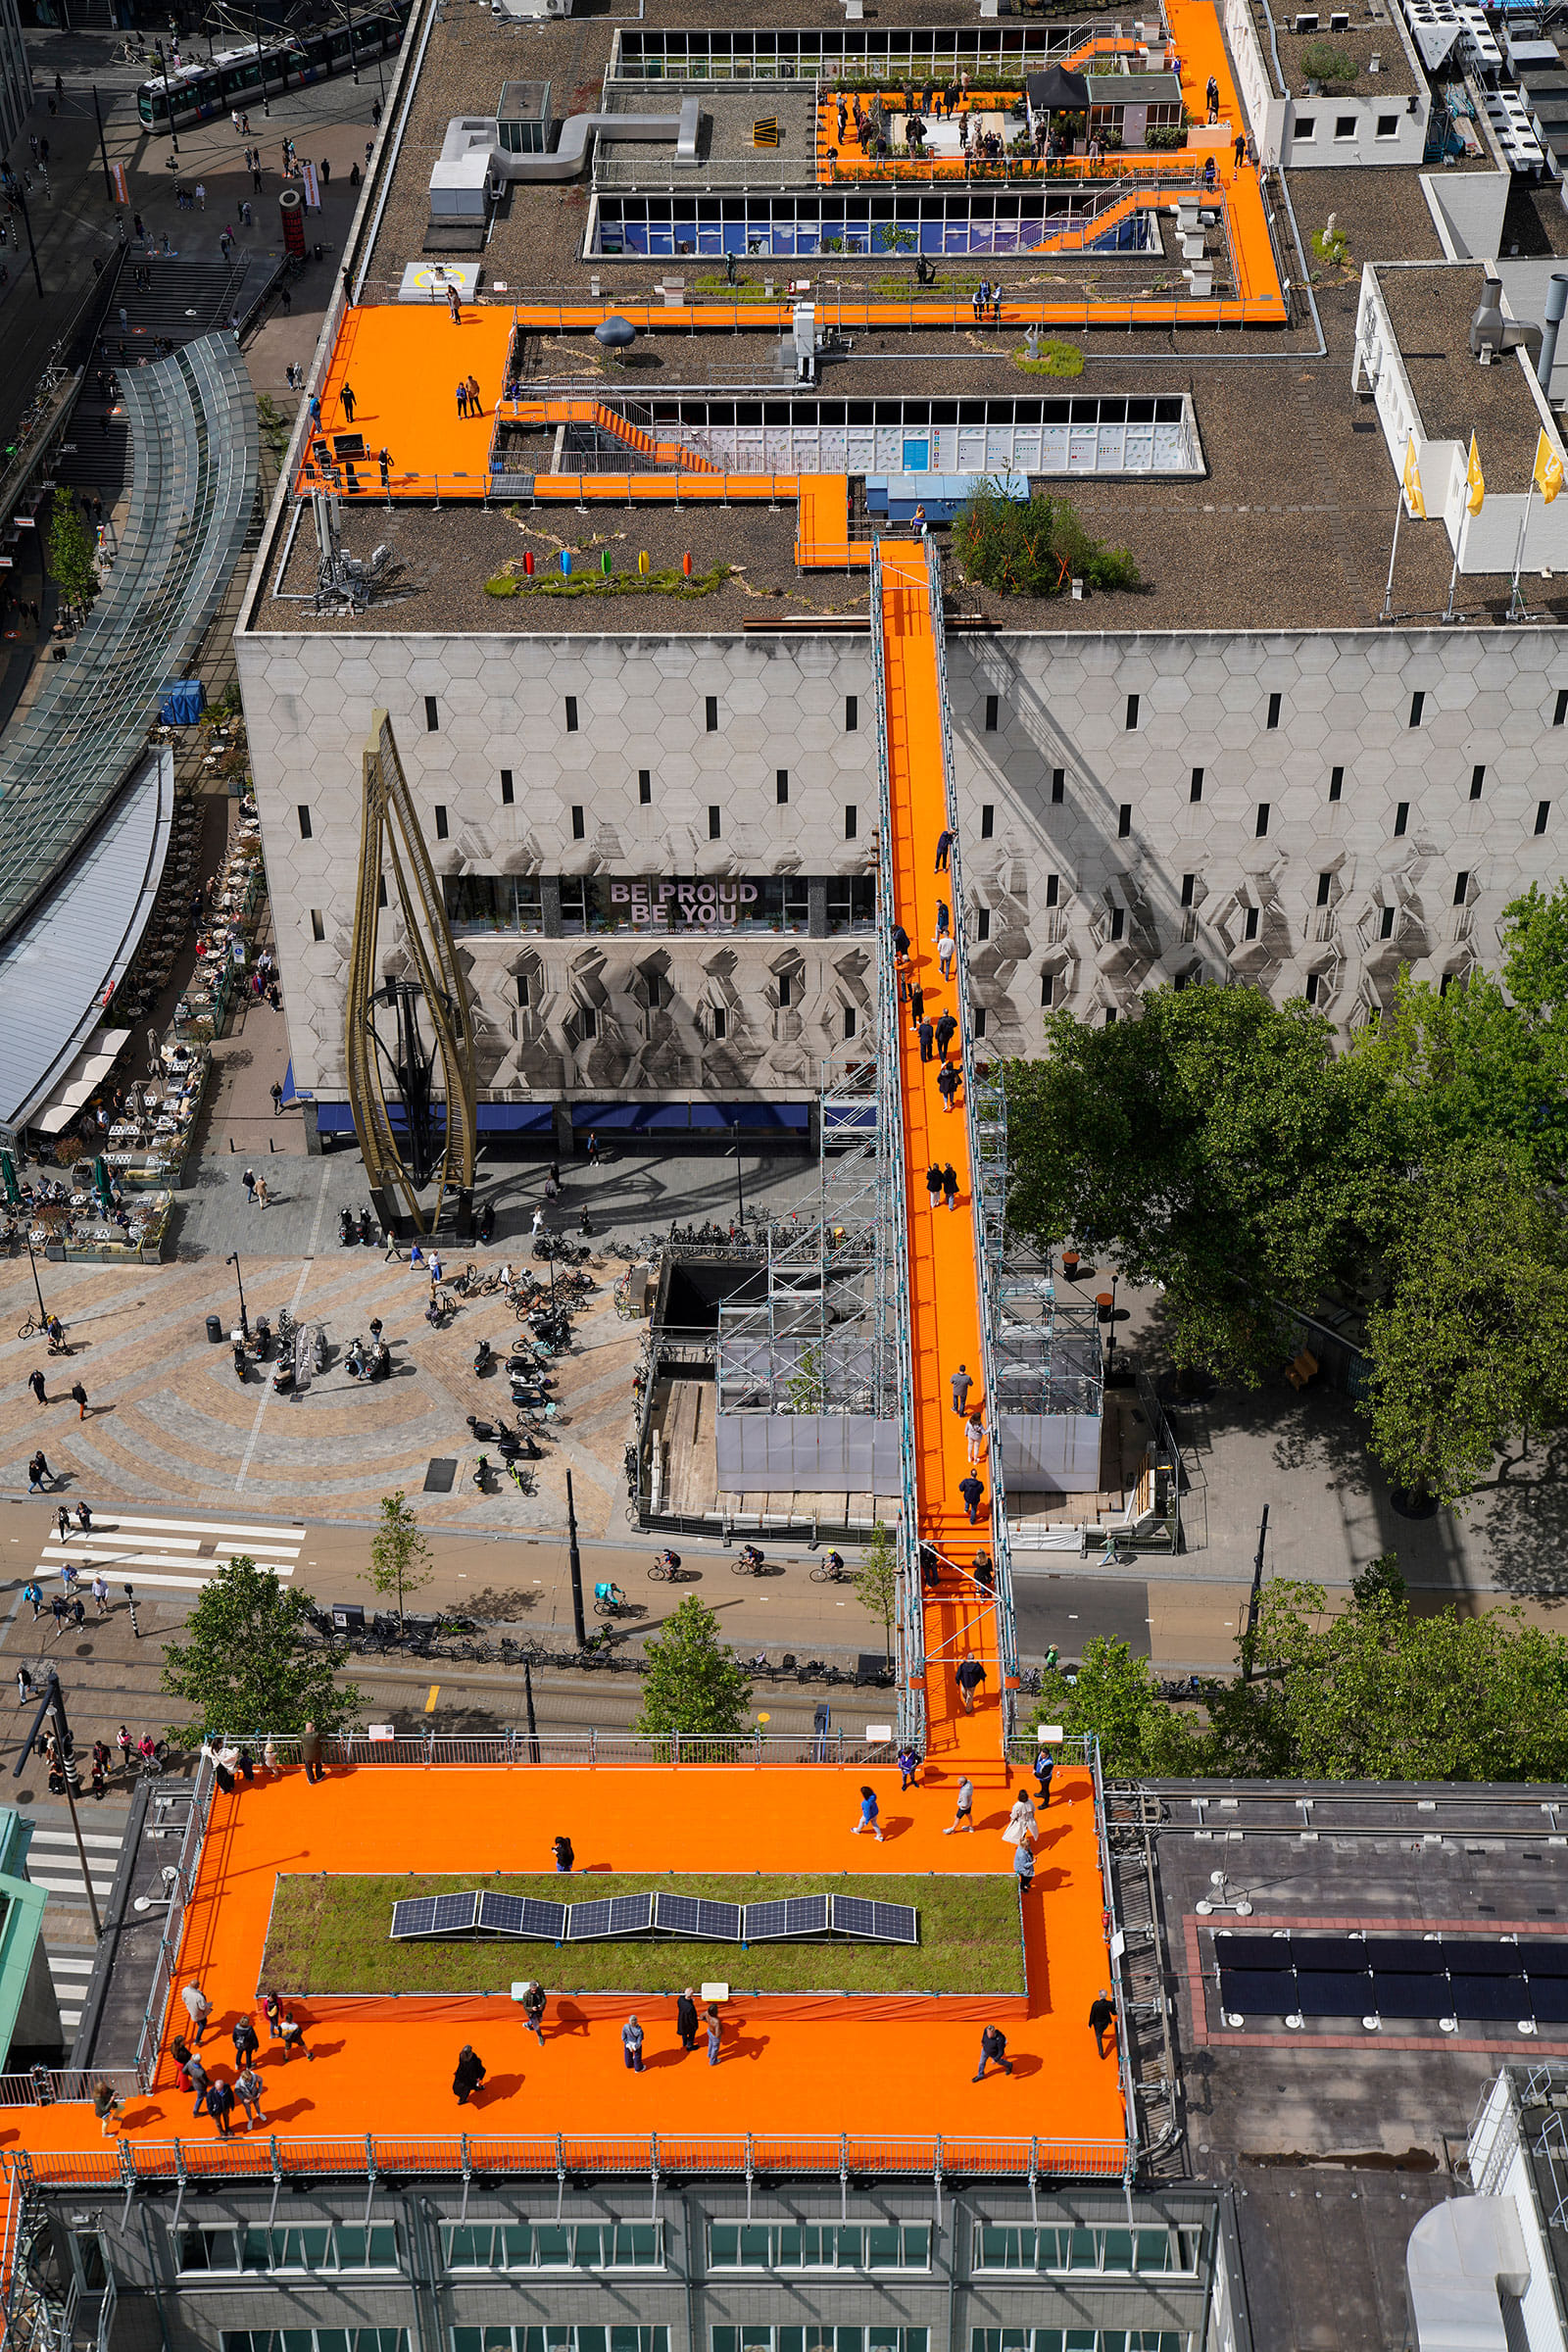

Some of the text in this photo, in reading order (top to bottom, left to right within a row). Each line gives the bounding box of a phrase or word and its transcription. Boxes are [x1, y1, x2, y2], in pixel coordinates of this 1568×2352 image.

[611, 884, 758, 903] BE PROUD
[631, 905, 737, 923] BE YOU
